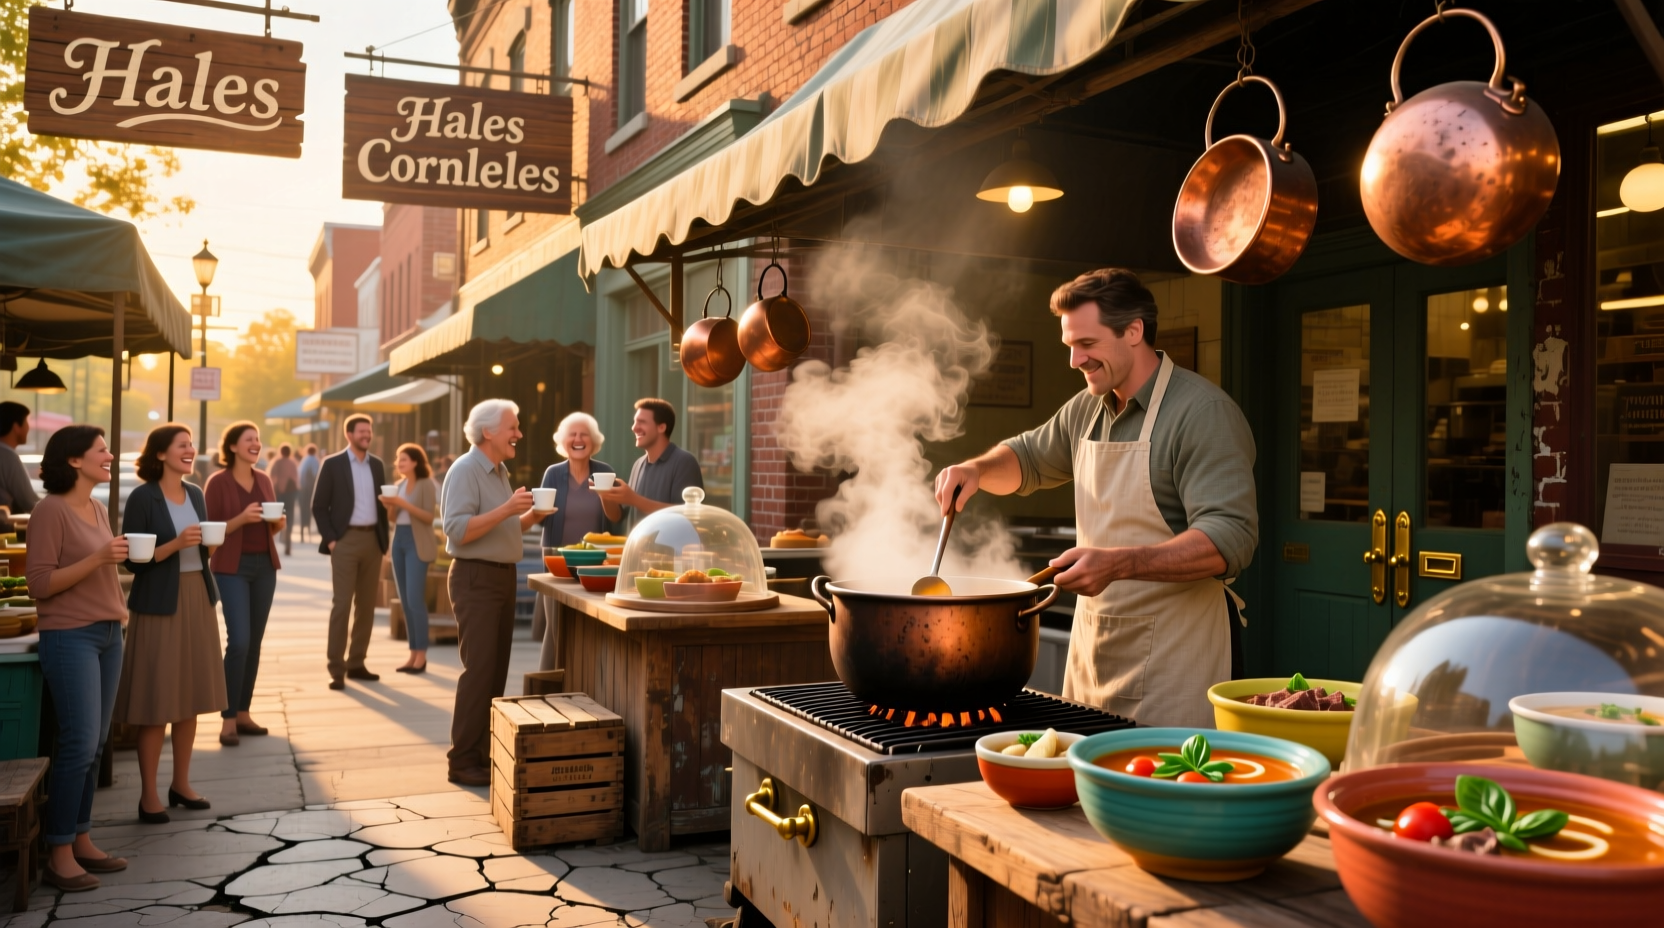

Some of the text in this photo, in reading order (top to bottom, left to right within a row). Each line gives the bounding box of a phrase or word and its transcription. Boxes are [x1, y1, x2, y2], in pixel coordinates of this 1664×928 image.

[49, 37, 280, 119] Hales
[390, 96, 525, 144] Hales
[357, 138, 560, 193] Cornleles
